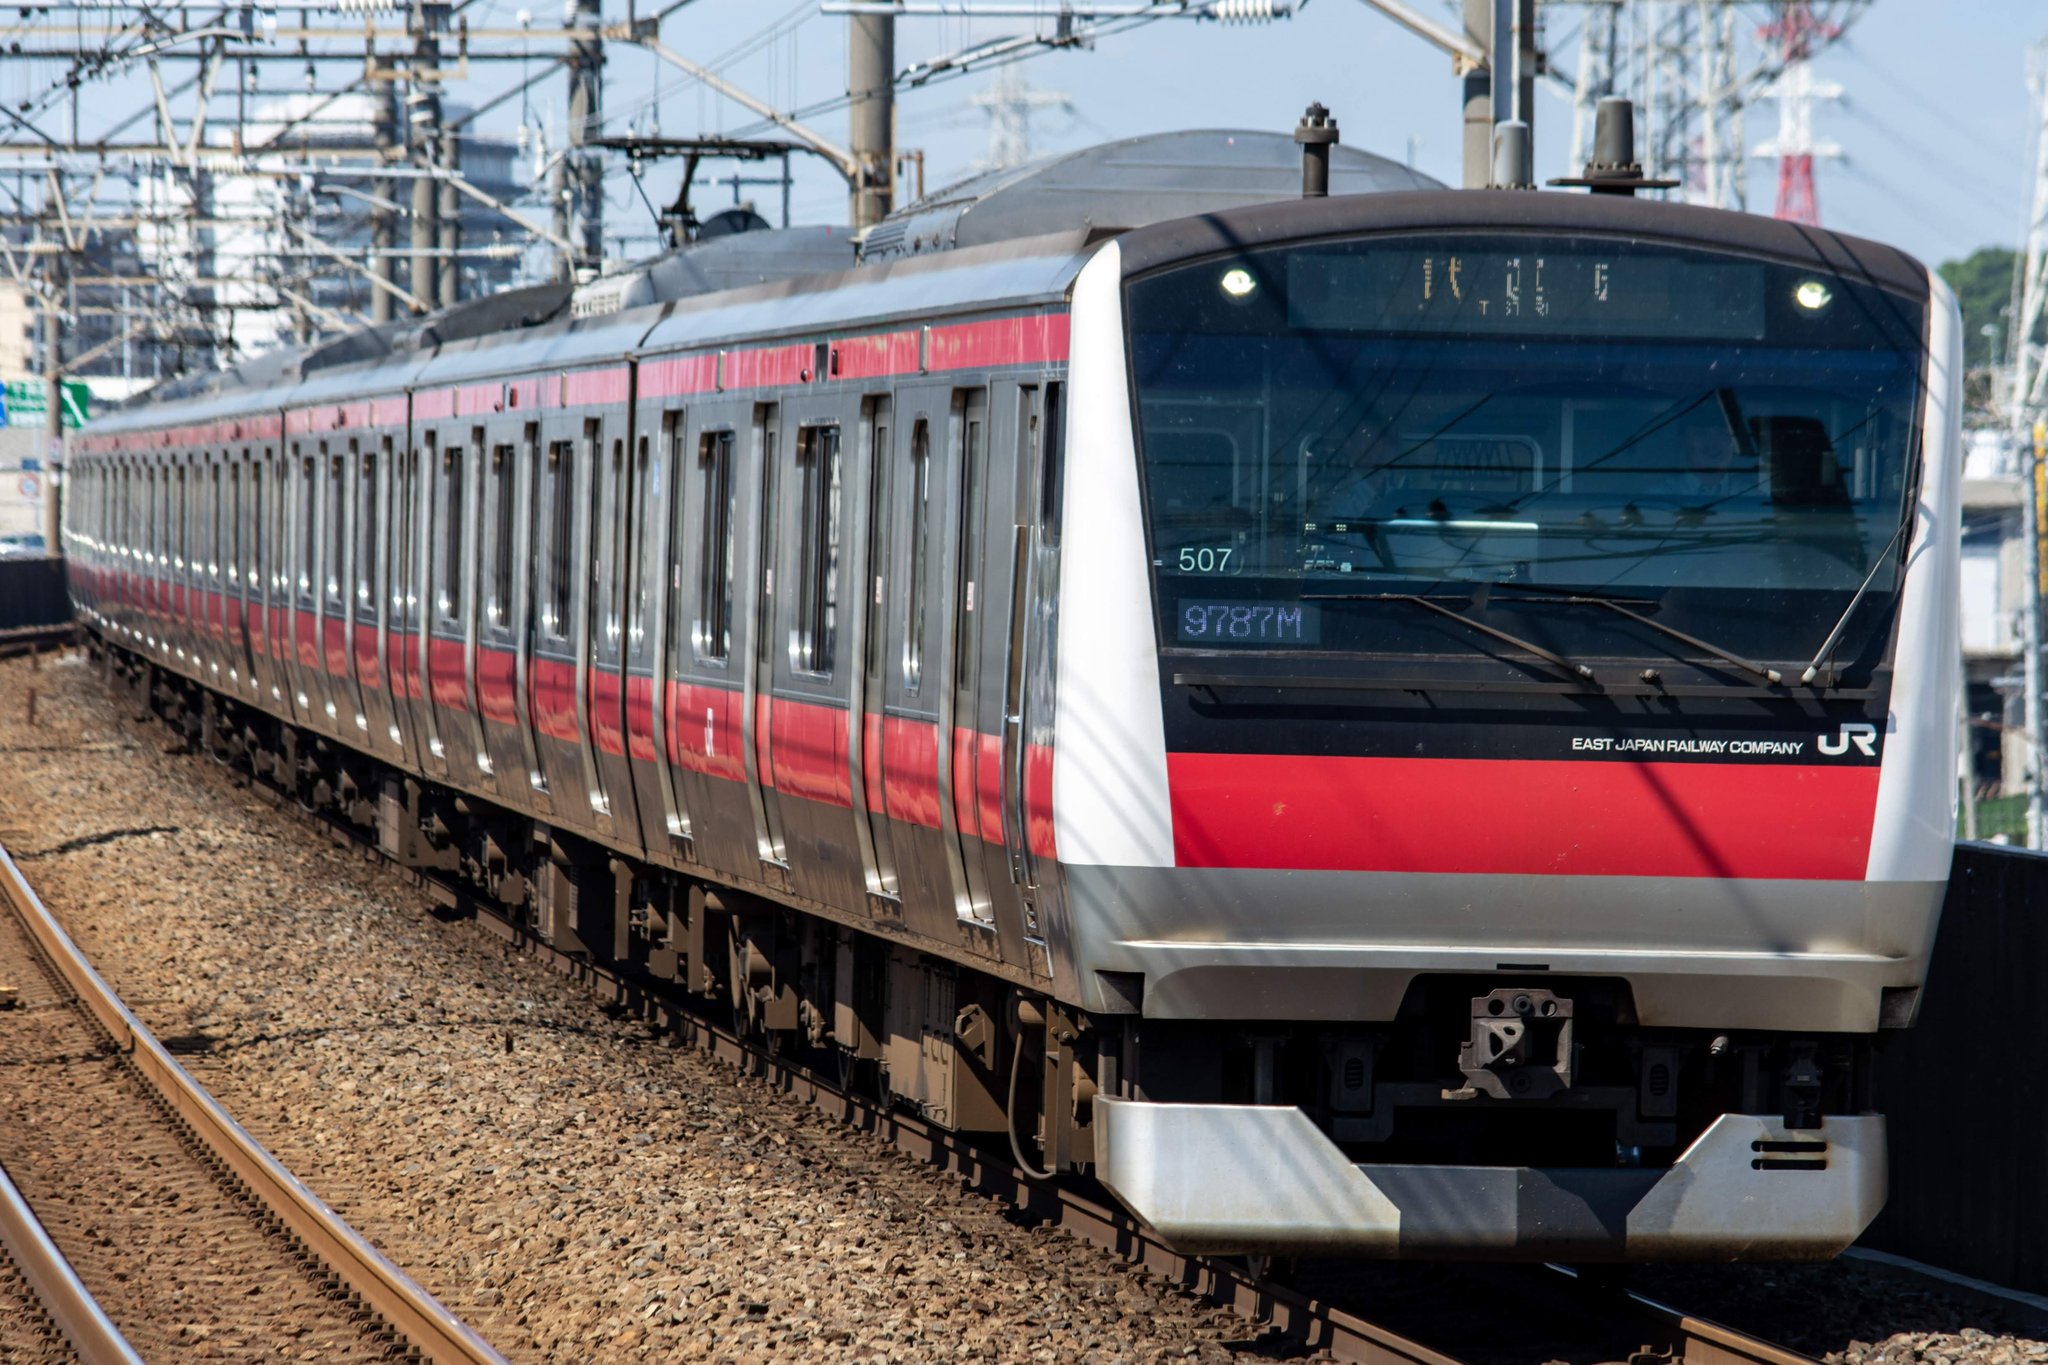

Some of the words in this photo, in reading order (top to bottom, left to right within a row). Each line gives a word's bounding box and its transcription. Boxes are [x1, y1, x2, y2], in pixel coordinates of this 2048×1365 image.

[1179, 548, 1232, 572] 507
[1184, 605, 1302, 638] 9787M
[1572, 738, 1614, 751] EAST
[1615, 739, 1665, 752] JAPAN
[1666, 740, 1727, 754] RAILWAY
[1729, 741, 1803, 755] COMPANY
[1817, 723, 1877, 756] JR
